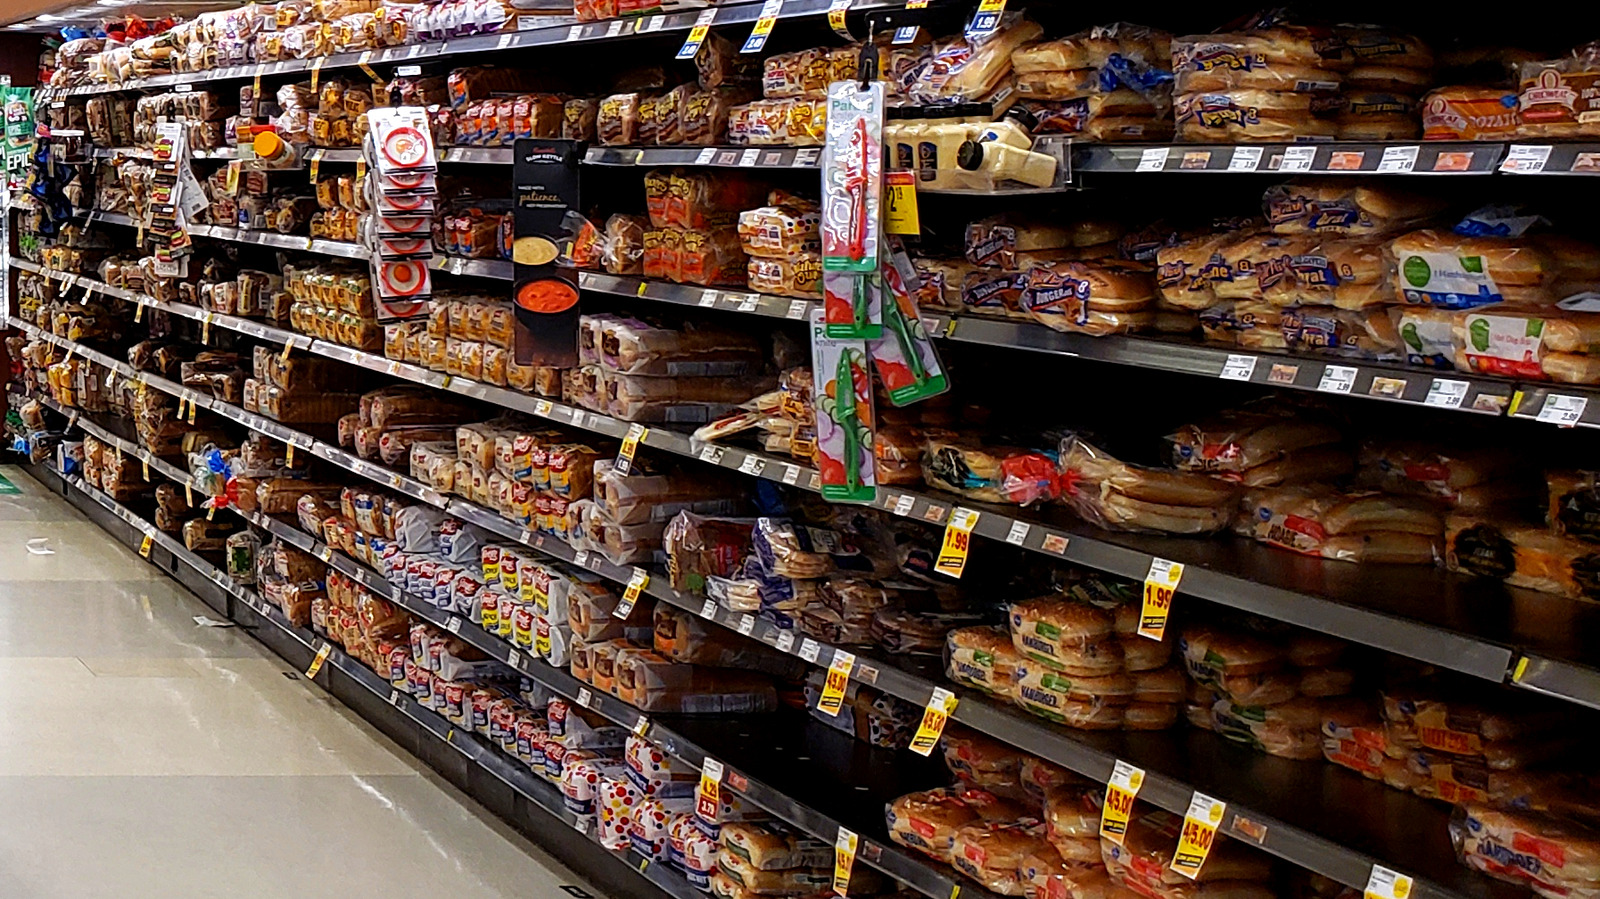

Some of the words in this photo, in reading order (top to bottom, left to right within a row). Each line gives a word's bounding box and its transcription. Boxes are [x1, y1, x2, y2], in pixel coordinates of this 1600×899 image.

[977, 16, 996, 29] 1.99
[833, 100, 874, 114] Parg
[7, 151, 32, 172] EPIC
[1078, 279, 1089, 293] 8
[1035, 288, 1063, 305] BURGER
[946, 528, 968, 552] 1.99
[1146, 584, 1172, 610] 1.99
[1183, 821, 1213, 850] 4/5.00
